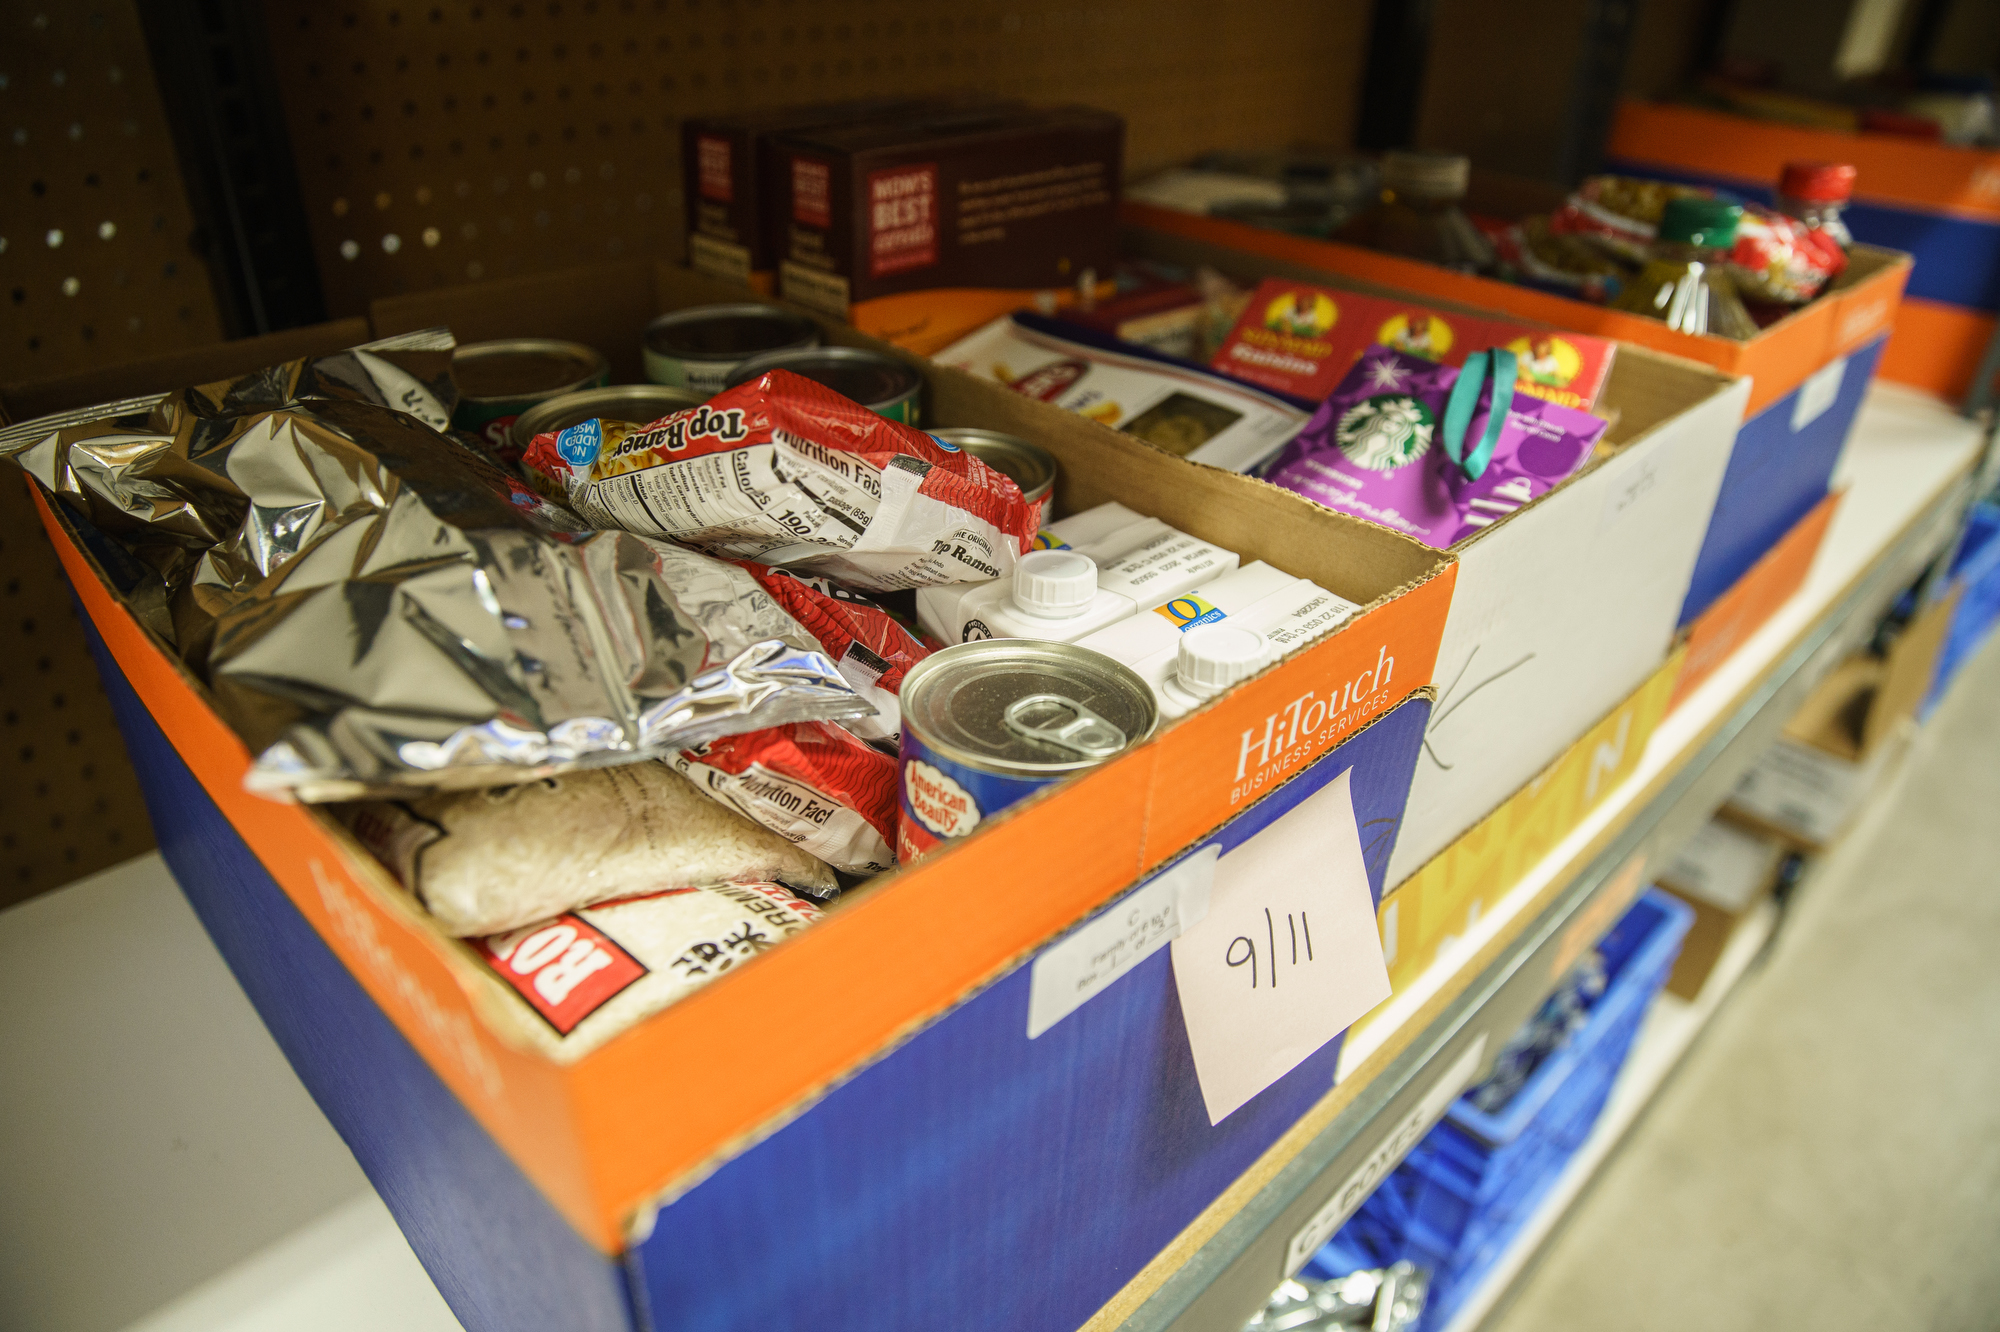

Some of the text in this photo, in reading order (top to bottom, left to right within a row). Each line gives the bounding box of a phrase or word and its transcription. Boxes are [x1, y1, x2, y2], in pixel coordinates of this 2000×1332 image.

[574, 422, 596, 434] MSG
[691, 408, 746, 441] Top
[566, 434, 598, 447] ADDED
[572, 446, 587, 457] NO
[775, 429, 850, 477] Nutrition
[616, 478, 628, 503] Calcium
[624, 476, 636, 500] Vitamin
[636, 474, 649, 500] Protein
[678, 464, 690, 492] Sodium
[686, 462, 706, 503] Cholesterol
[601, 482, 616, 512] Potassium
[669, 466, 704, 527] Total Carbohydrate
[779, 509, 811, 535] 190
[850, 507, 872, 526] (85g)
[932, 540, 1000, 577] Tp Ramen
[968, 532, 994, 558] ORIGINAL
[1234, 645, 1394, 783] HiTouch
[1230, 740, 1312, 805] BUSINESS
[1318, 690, 1388, 746] SERVICES
[740, 774, 802, 812] Nutrition
[912, 763, 966, 814] American
[915, 788, 958, 832] Beauty
[1128, 908, 1140, 926] C
[1226, 907, 1314, 988] 9/11
[486, 924, 614, 1006] RO
